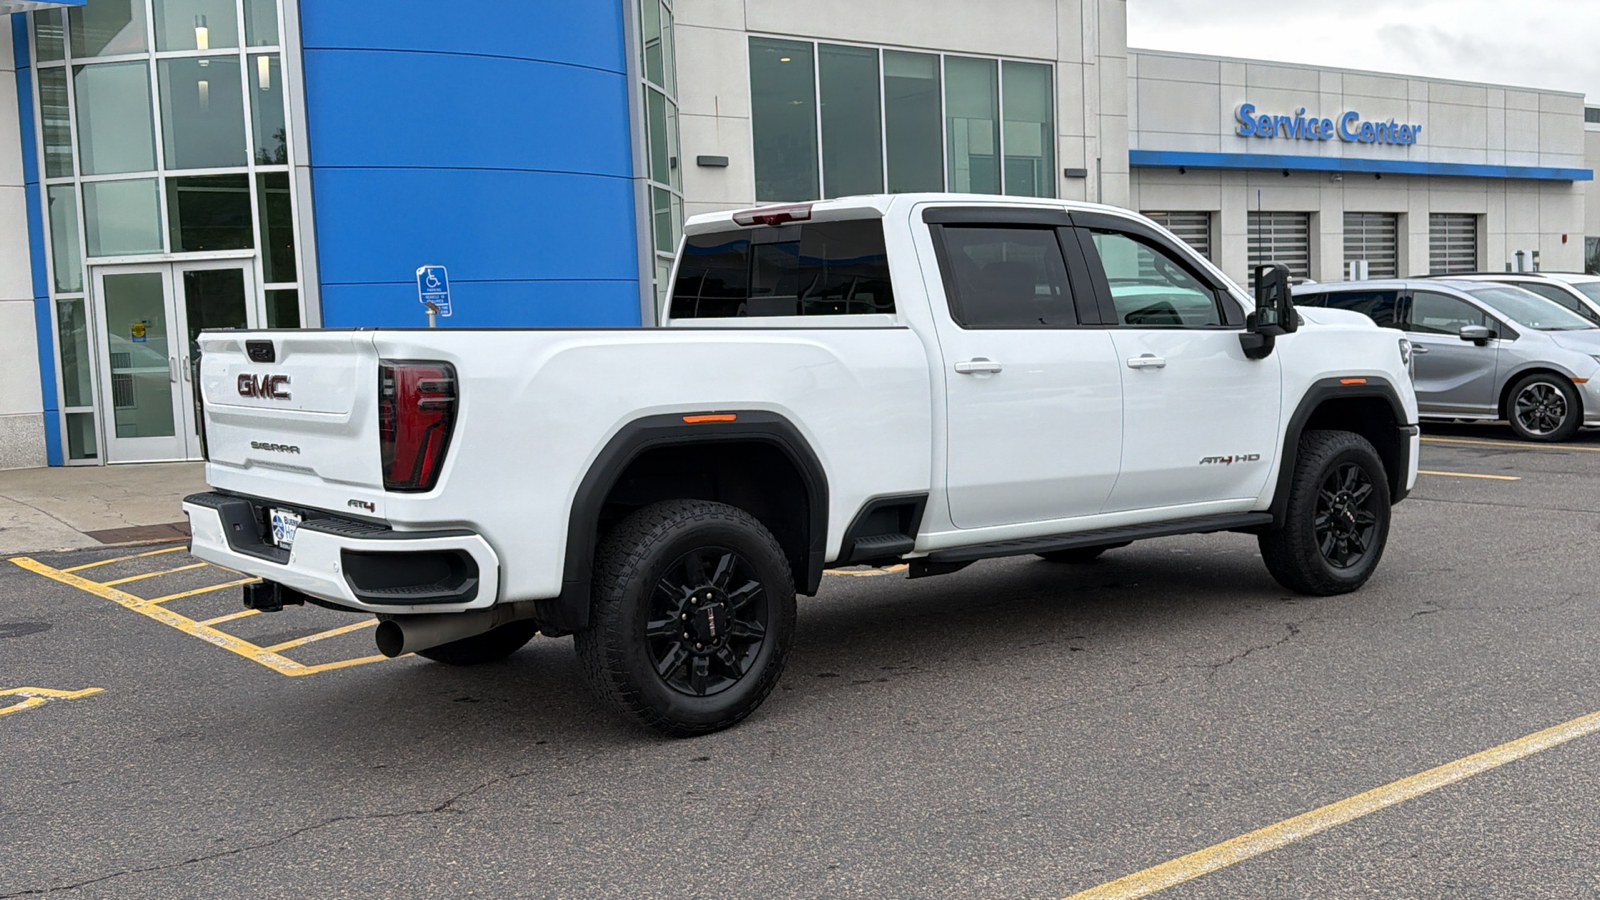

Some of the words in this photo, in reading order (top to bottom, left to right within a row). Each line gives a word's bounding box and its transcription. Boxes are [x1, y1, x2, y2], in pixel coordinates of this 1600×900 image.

[1236, 103, 1334, 140] Service
[1337, 111, 1422, 145] Center
[238, 373, 291, 401] GMC
[251, 441, 301, 455] SIERRA
[1199, 456, 1232, 465] AT4
[1235, 454, 1260, 462] HD
[347, 499, 375, 513] AT4
